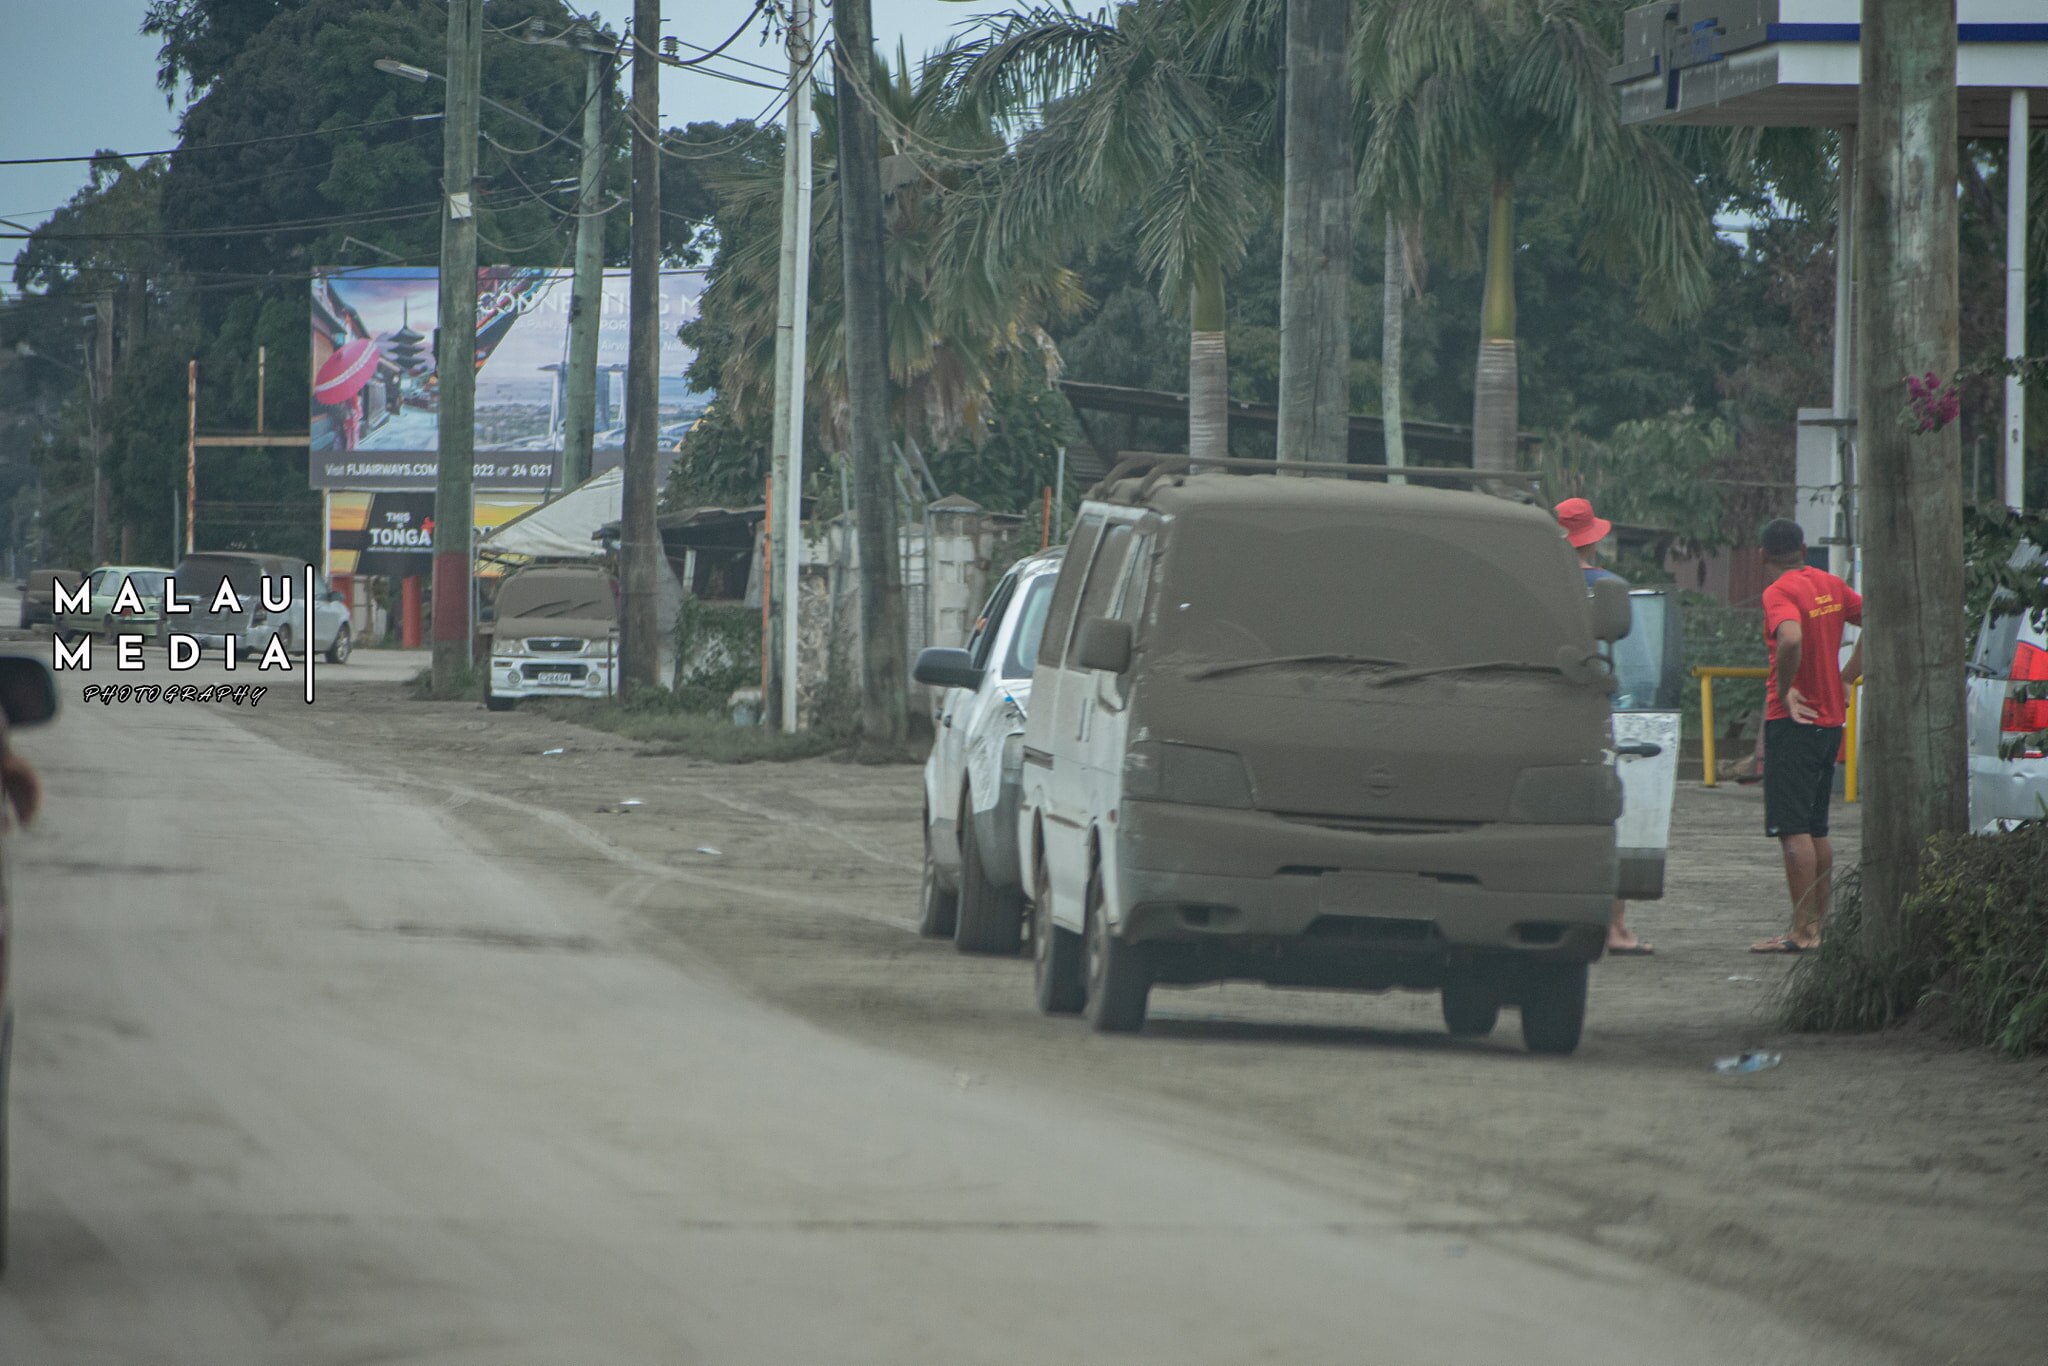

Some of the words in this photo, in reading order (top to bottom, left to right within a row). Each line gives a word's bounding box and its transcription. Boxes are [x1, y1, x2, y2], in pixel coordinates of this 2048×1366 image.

[478, 291, 670, 315] CONNETIG
[512, 463, 528, 477] 24
[530, 463, 552, 477] 021
[369, 527, 432, 546] TONGA
